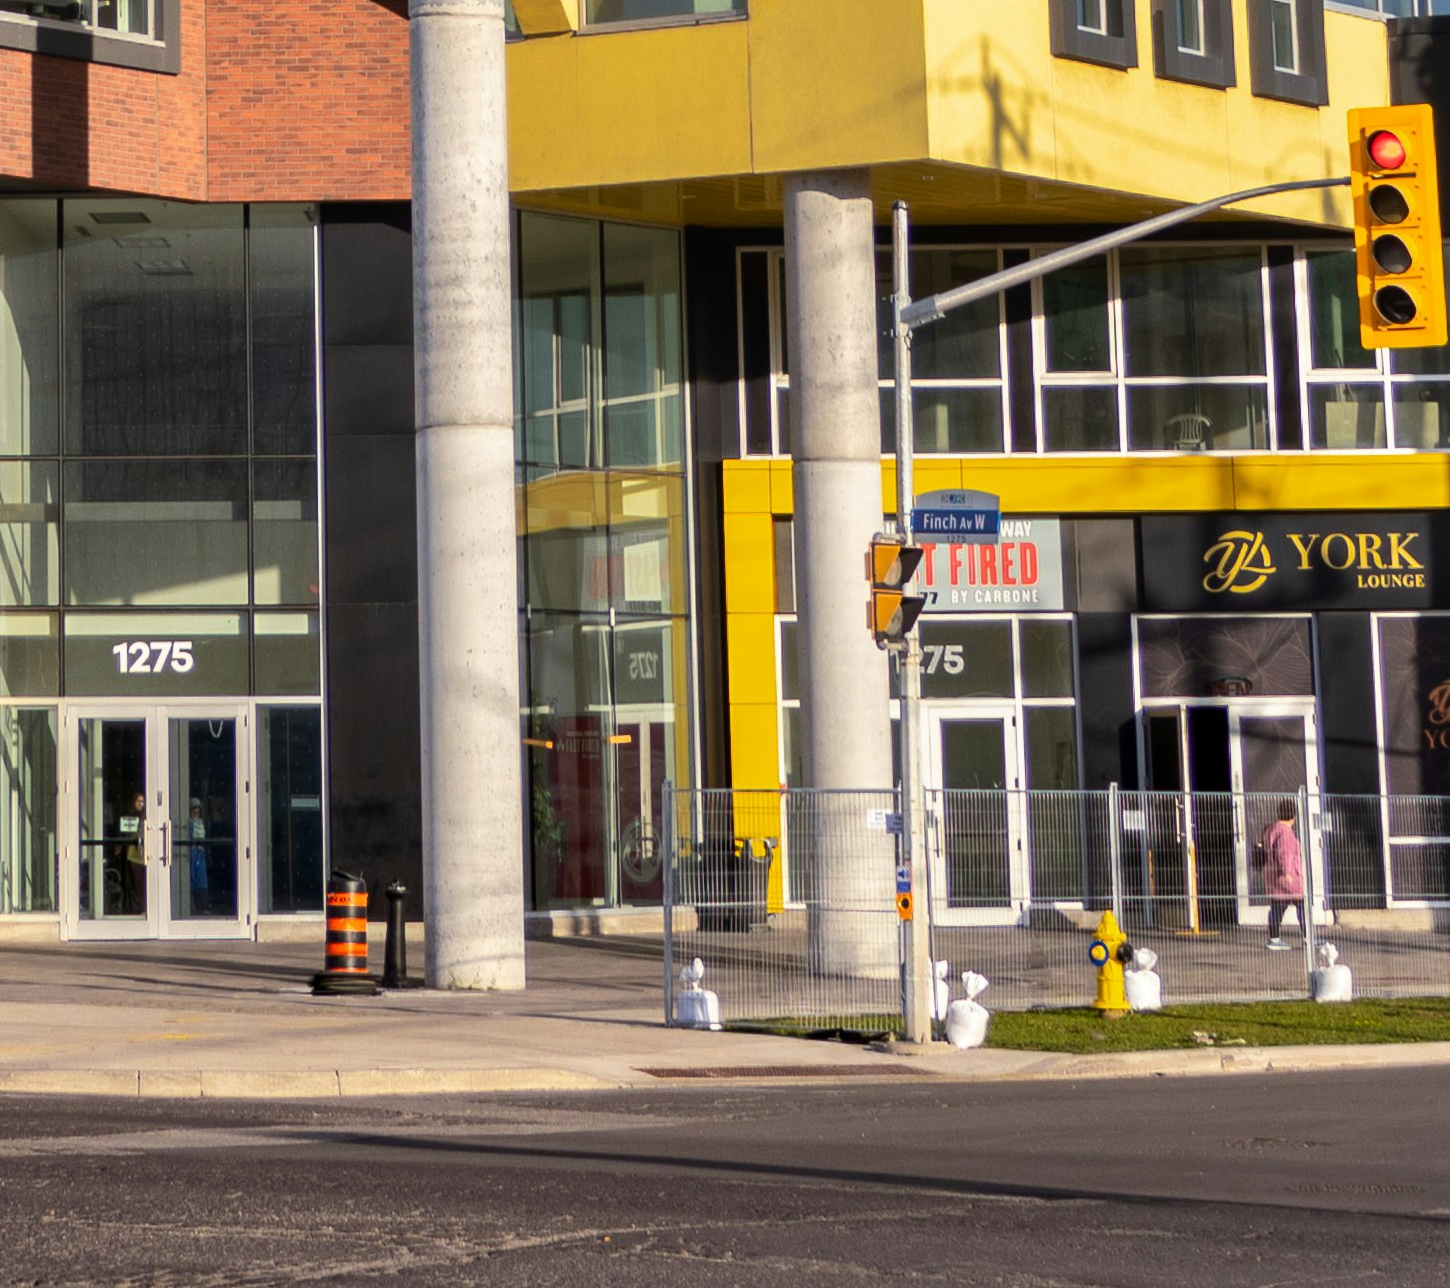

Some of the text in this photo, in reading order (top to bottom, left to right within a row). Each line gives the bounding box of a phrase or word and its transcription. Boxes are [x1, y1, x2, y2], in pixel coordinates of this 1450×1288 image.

[923, 513, 985, 530] Finch Av W
[1000, 520, 1032, 537] WAY
[946, 535, 966, 544] 1275
[1286, 533, 1425, 570] YORK
[948, 542, 1039, 586] FIRED
[1357, 574, 1425, 589] LOUNGE
[951, 590, 967, 603] BY
[974, 589, 1039, 603] CARBONE
[113, 641, 194, 673] 1275
[889, 645, 965, 674] 175
